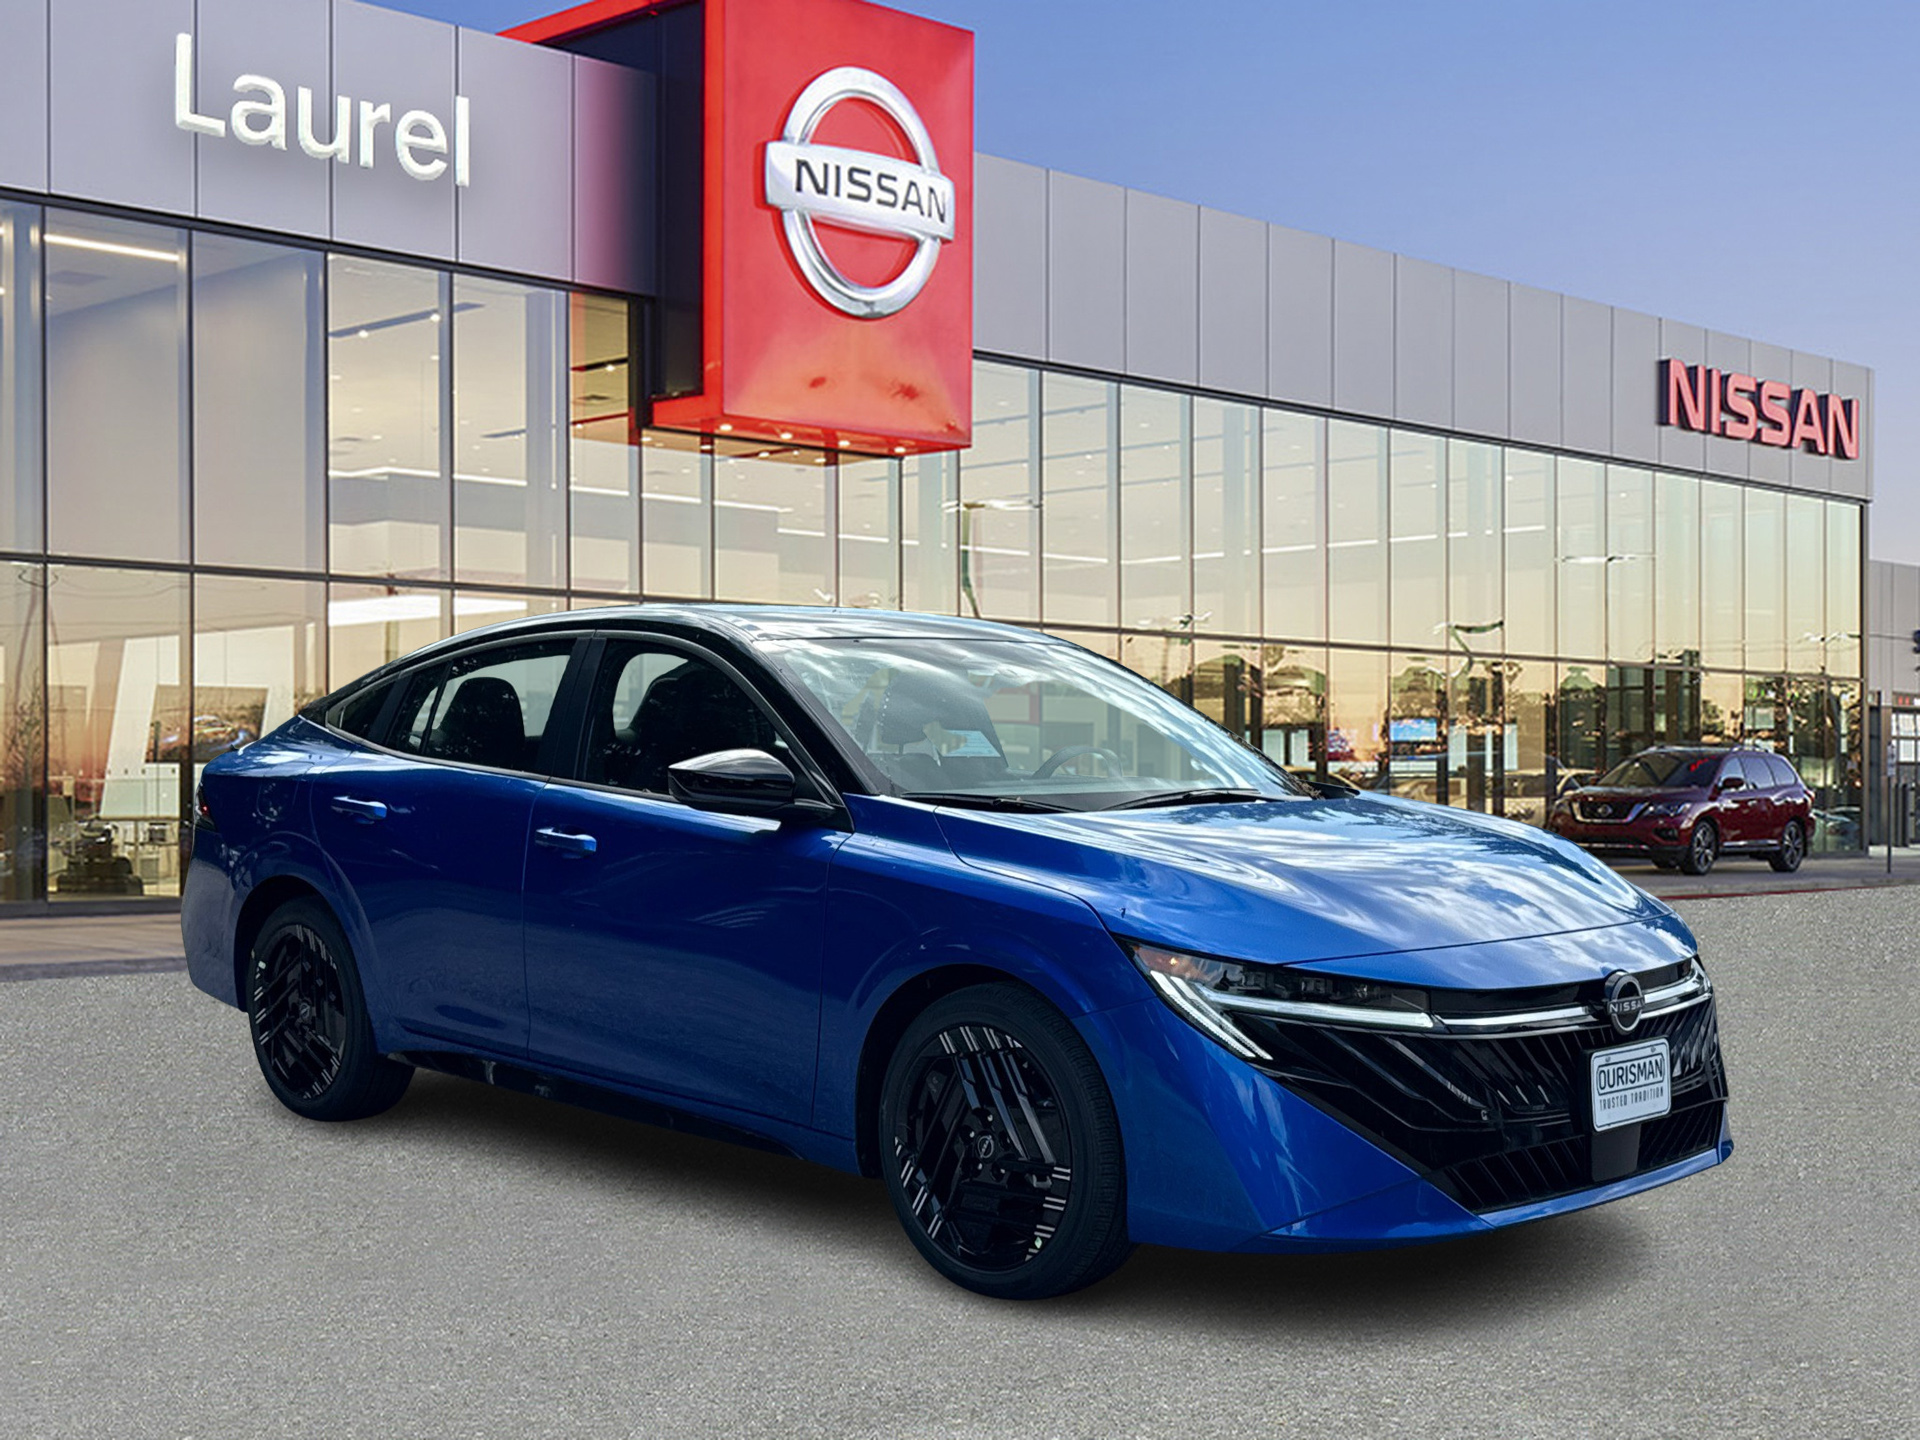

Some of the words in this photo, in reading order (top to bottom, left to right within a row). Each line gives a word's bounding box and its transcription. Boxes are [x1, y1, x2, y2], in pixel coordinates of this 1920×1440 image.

[175, 32, 470, 188] Laurel
[795, 158, 947, 223] NISSAN
[1658, 358, 1860, 460] NISSAN
[1599, 1058, 1664, 1090] OURISMAN
[1599, 1094, 1628, 1111] TRUSTED
[1630, 1085, 1664, 1104] TRADITION
